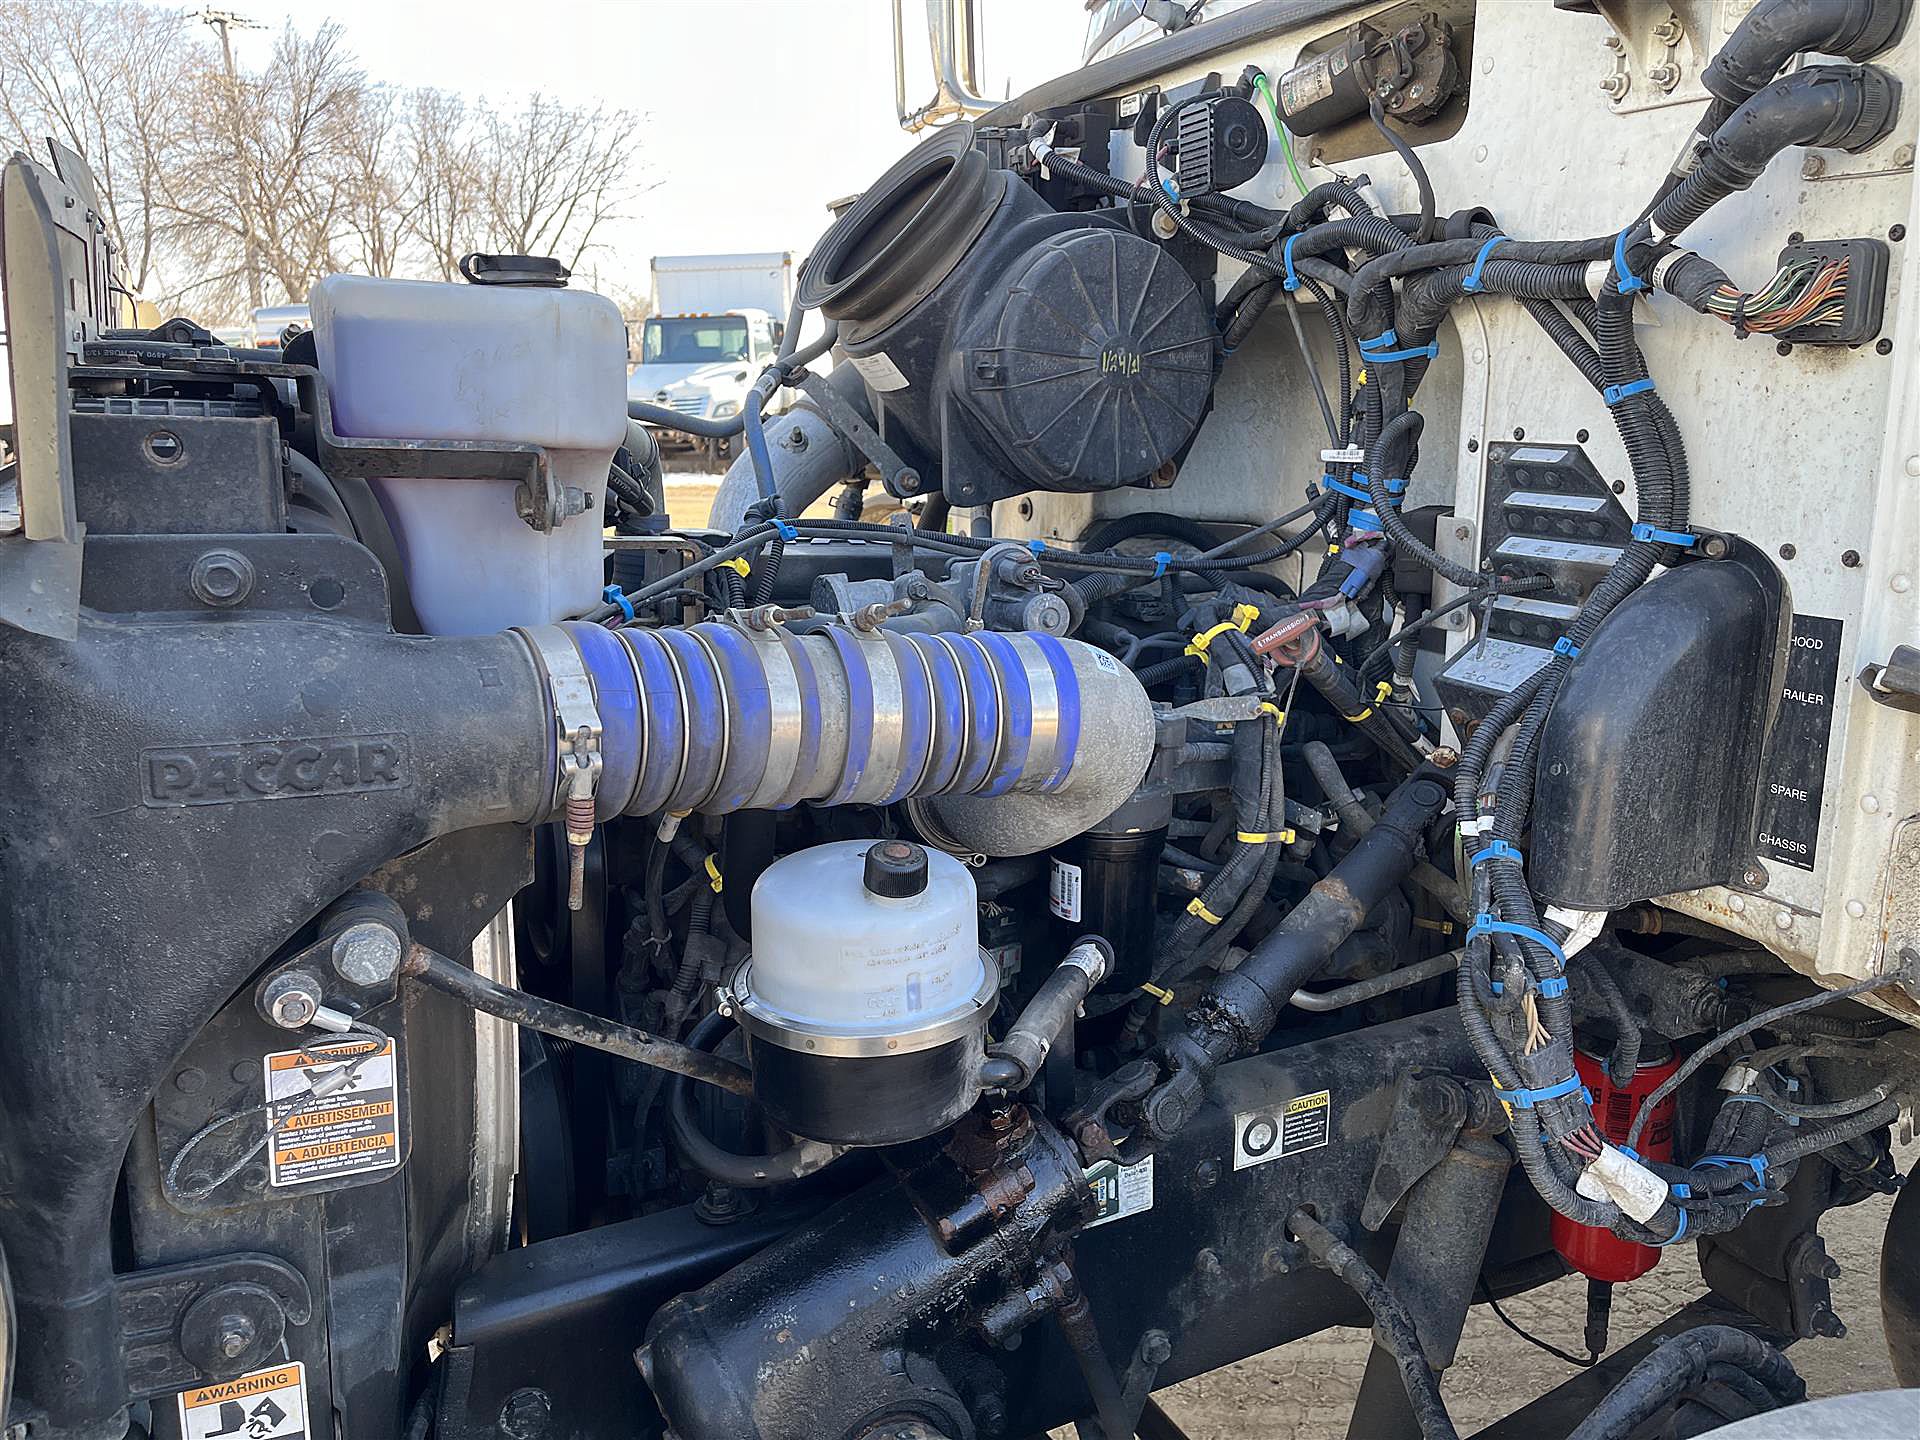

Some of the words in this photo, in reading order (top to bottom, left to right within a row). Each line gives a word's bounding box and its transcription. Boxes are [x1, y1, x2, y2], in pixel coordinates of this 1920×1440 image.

[1262, 616, 1306, 646] TRANSMISSION
[1783, 688, 1824, 706] RAILER
[150, 744, 400, 799] PACCAR
[1770, 784, 1808, 802] SPARE
[1758, 833, 1807, 855] CHASSIS
[1291, 1095, 1327, 1111] CAUTION
[295, 1103, 391, 1127] AVERTISSEMENT
[302, 1136, 387, 1159] ADVERTENCIA
[209, 1373, 288, 1399] WARNING
